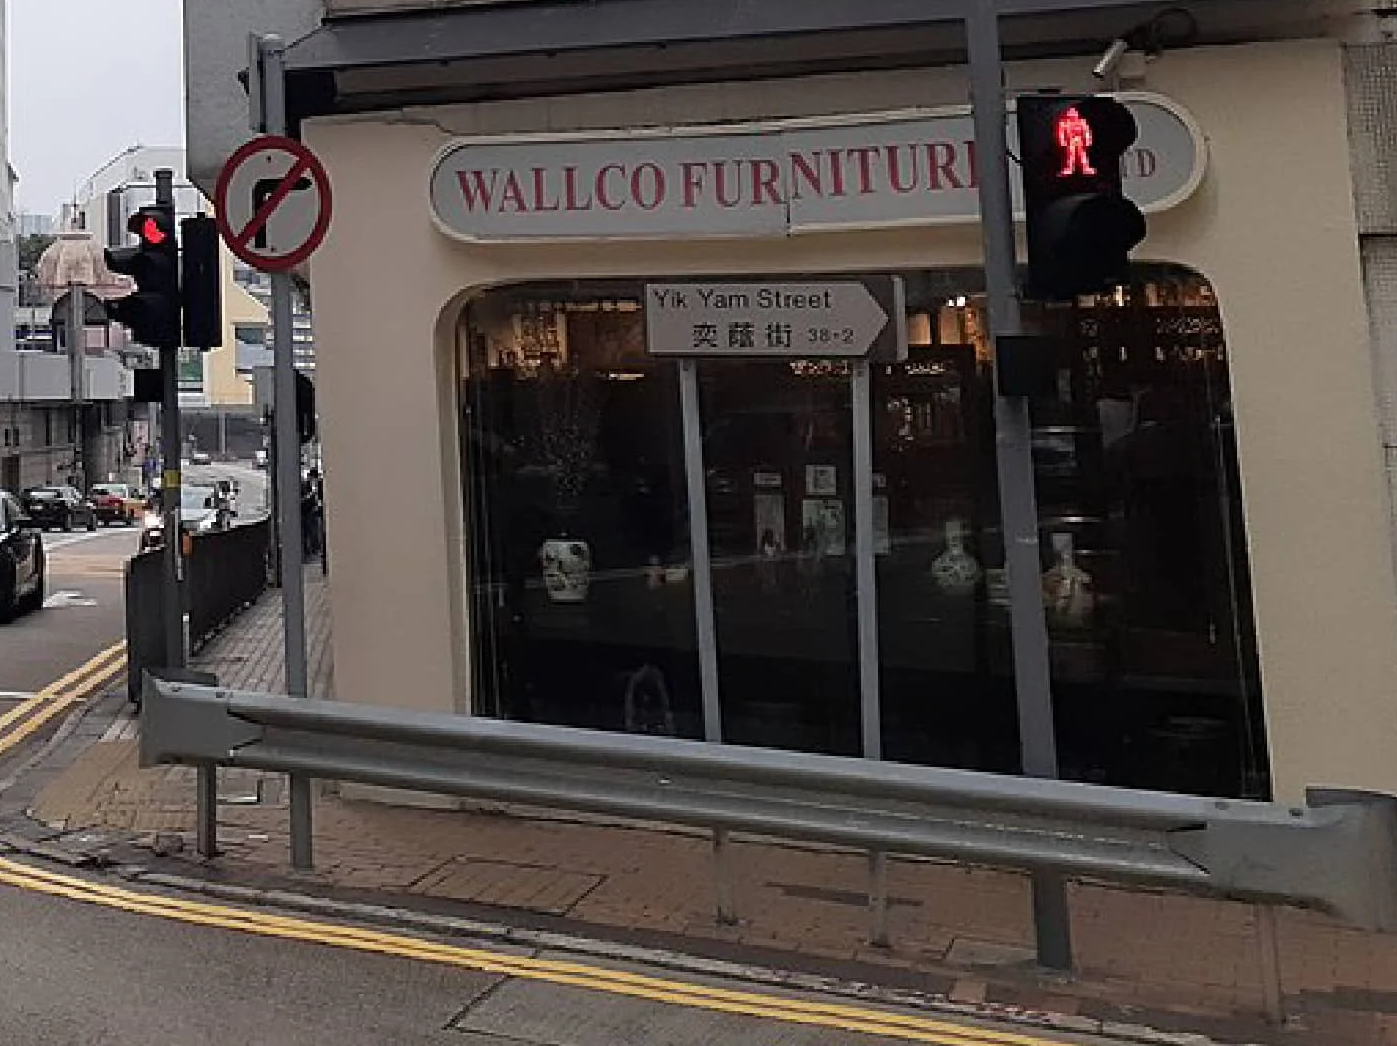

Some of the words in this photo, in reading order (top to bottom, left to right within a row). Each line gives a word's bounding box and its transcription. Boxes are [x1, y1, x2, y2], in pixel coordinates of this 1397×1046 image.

[455, 161, 666, 213] WALLCO
[653, 288, 688, 309] Yik
[695, 288, 750, 309] Yam
[756, 288, 833, 309] Street
